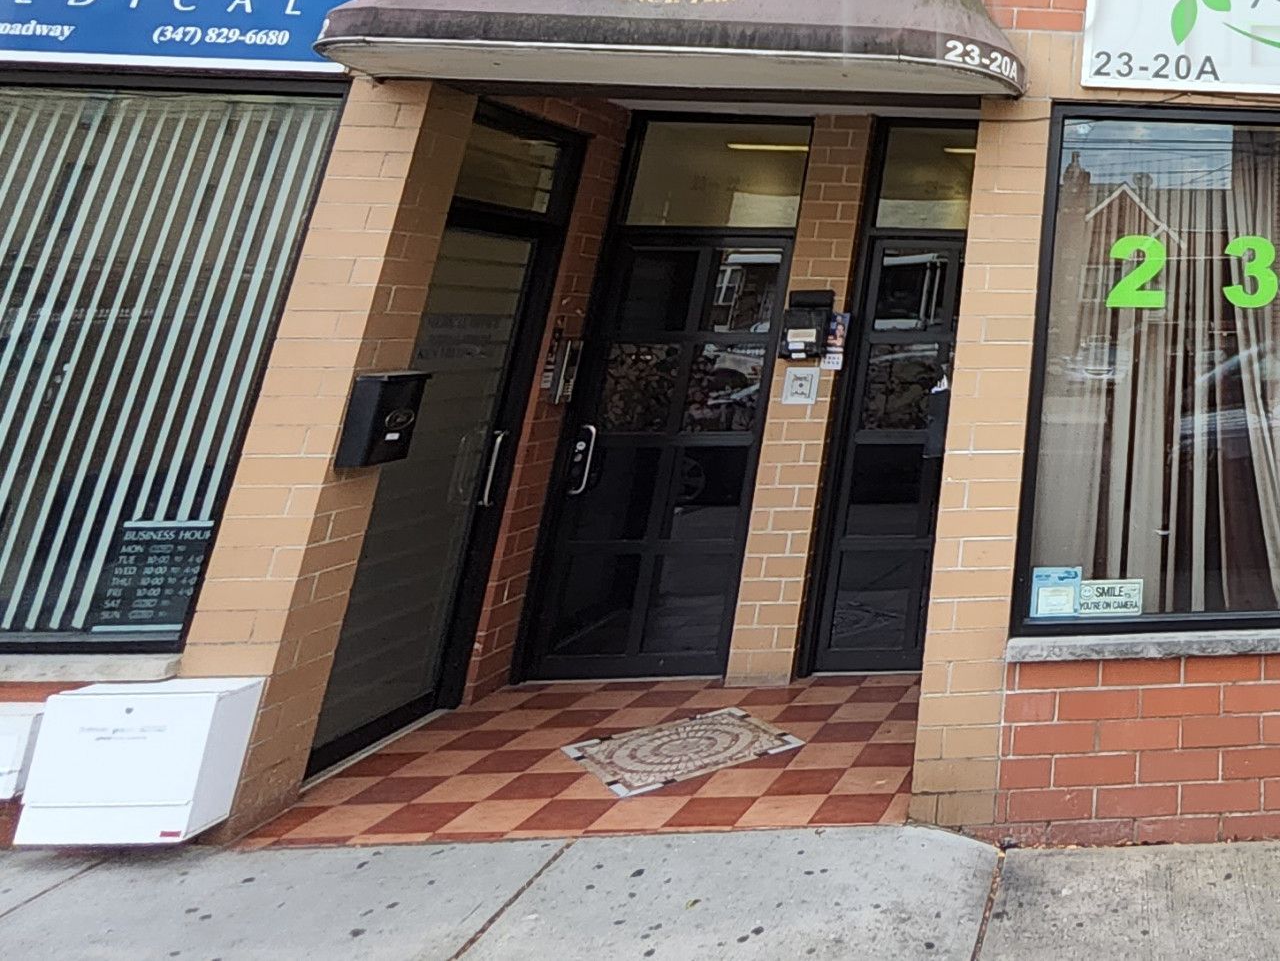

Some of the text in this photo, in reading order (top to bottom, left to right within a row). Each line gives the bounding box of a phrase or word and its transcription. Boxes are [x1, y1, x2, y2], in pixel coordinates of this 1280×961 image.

[152, 25, 201, 46] (347)
[204, 26, 290, 46] 829-6680
[945, 40, 1018, 82] 23-20A
[1092, 51, 1221, 81] 23-20A
[124, 530, 176, 541] BUSINESS
[120, 545, 144, 553] MON
[114, 567, 138, 575] WED
[1095, 586, 1124, 597] SMILE
[103, 599, 121, 608] SAT
[1112, 601, 1139, 609] CAMERA
